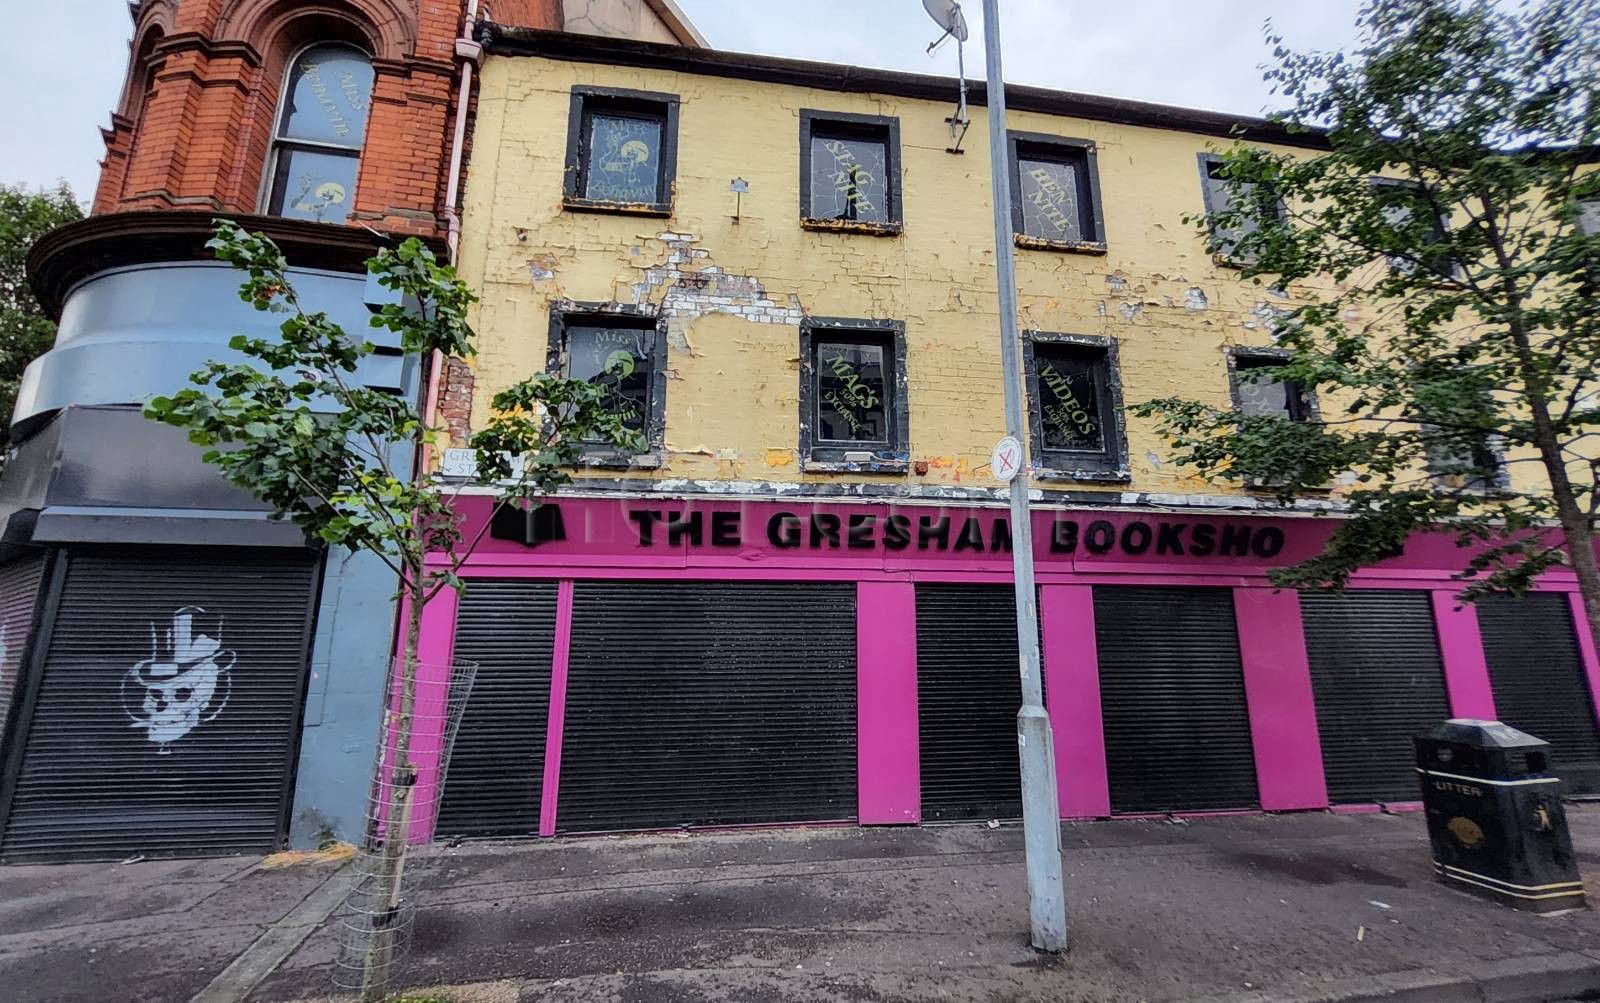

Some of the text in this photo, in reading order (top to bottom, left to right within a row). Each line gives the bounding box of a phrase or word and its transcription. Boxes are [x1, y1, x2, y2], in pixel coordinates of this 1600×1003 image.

[1040, 361, 1096, 435] VIDEOS
[629, 510, 739, 547] THE
[1050, 520, 1285, 558] BOOKSHO
